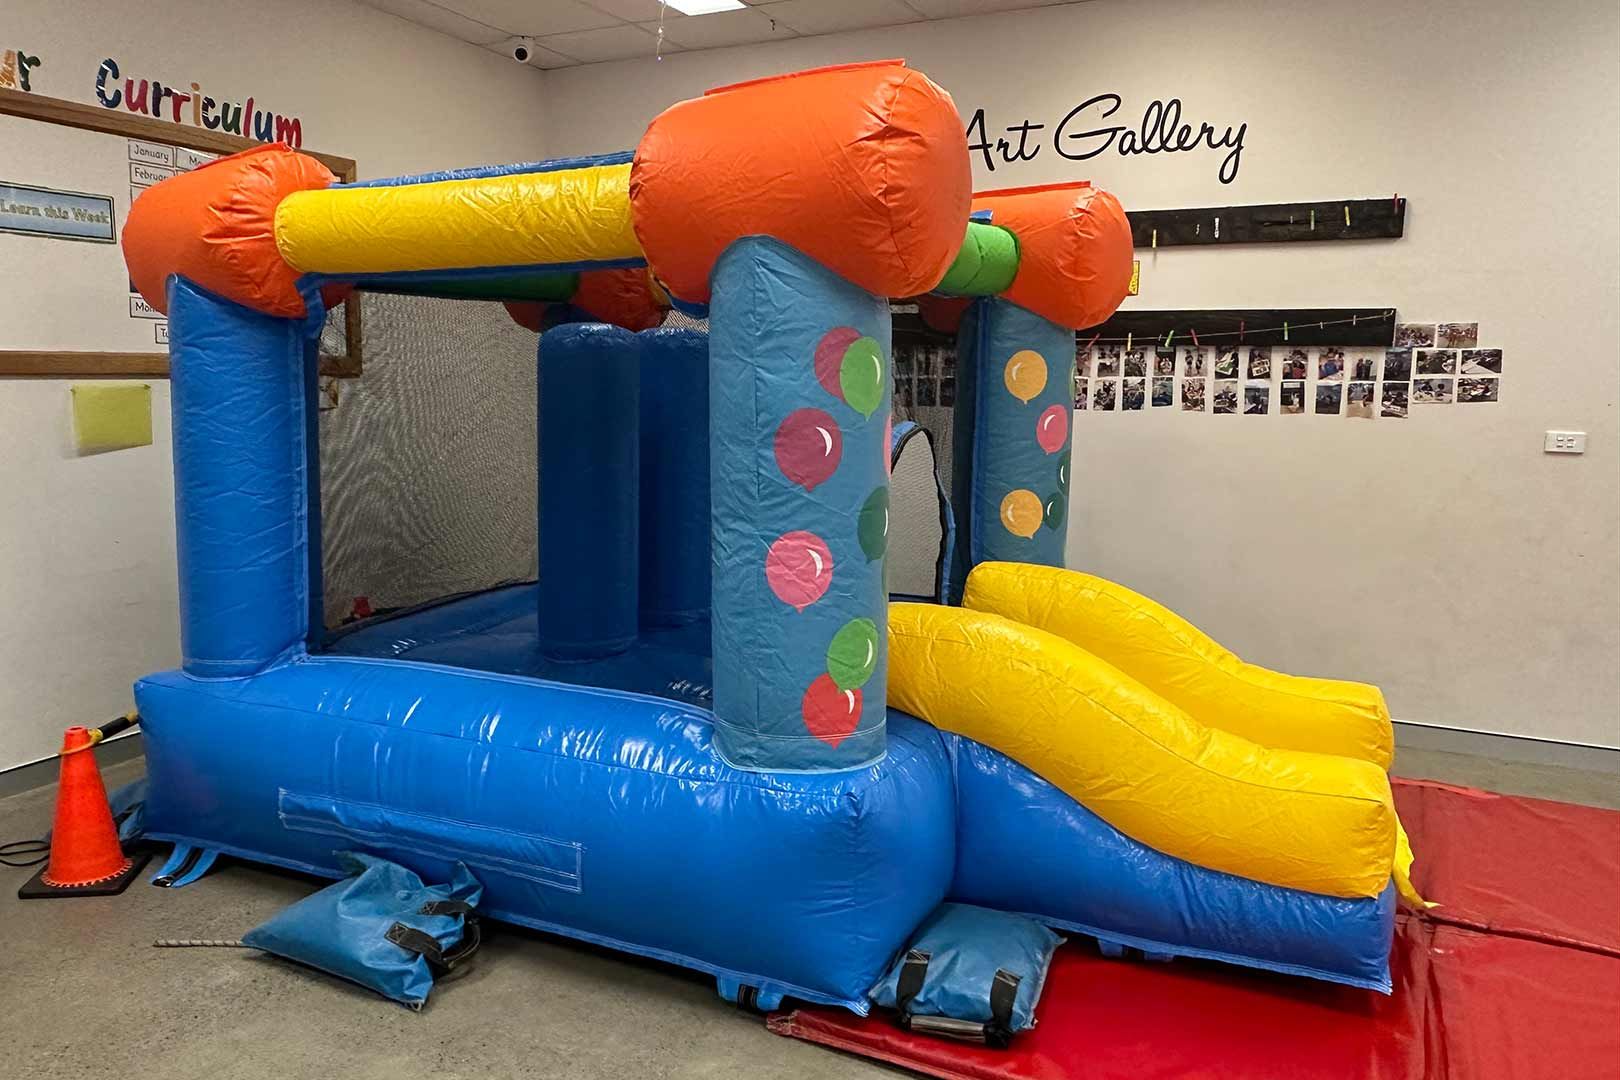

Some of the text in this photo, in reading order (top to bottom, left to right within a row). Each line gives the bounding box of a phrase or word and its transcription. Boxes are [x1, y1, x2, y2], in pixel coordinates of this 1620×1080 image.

[95, 58, 302, 148] Curriculum
[966, 93, 1247, 184] Art Gallery
[133, 144, 170, 164] January
[134, 167, 169, 181] Februar
[0, 199, 110, 224] Learn this Week
[135, 301, 156, 313] Mon
